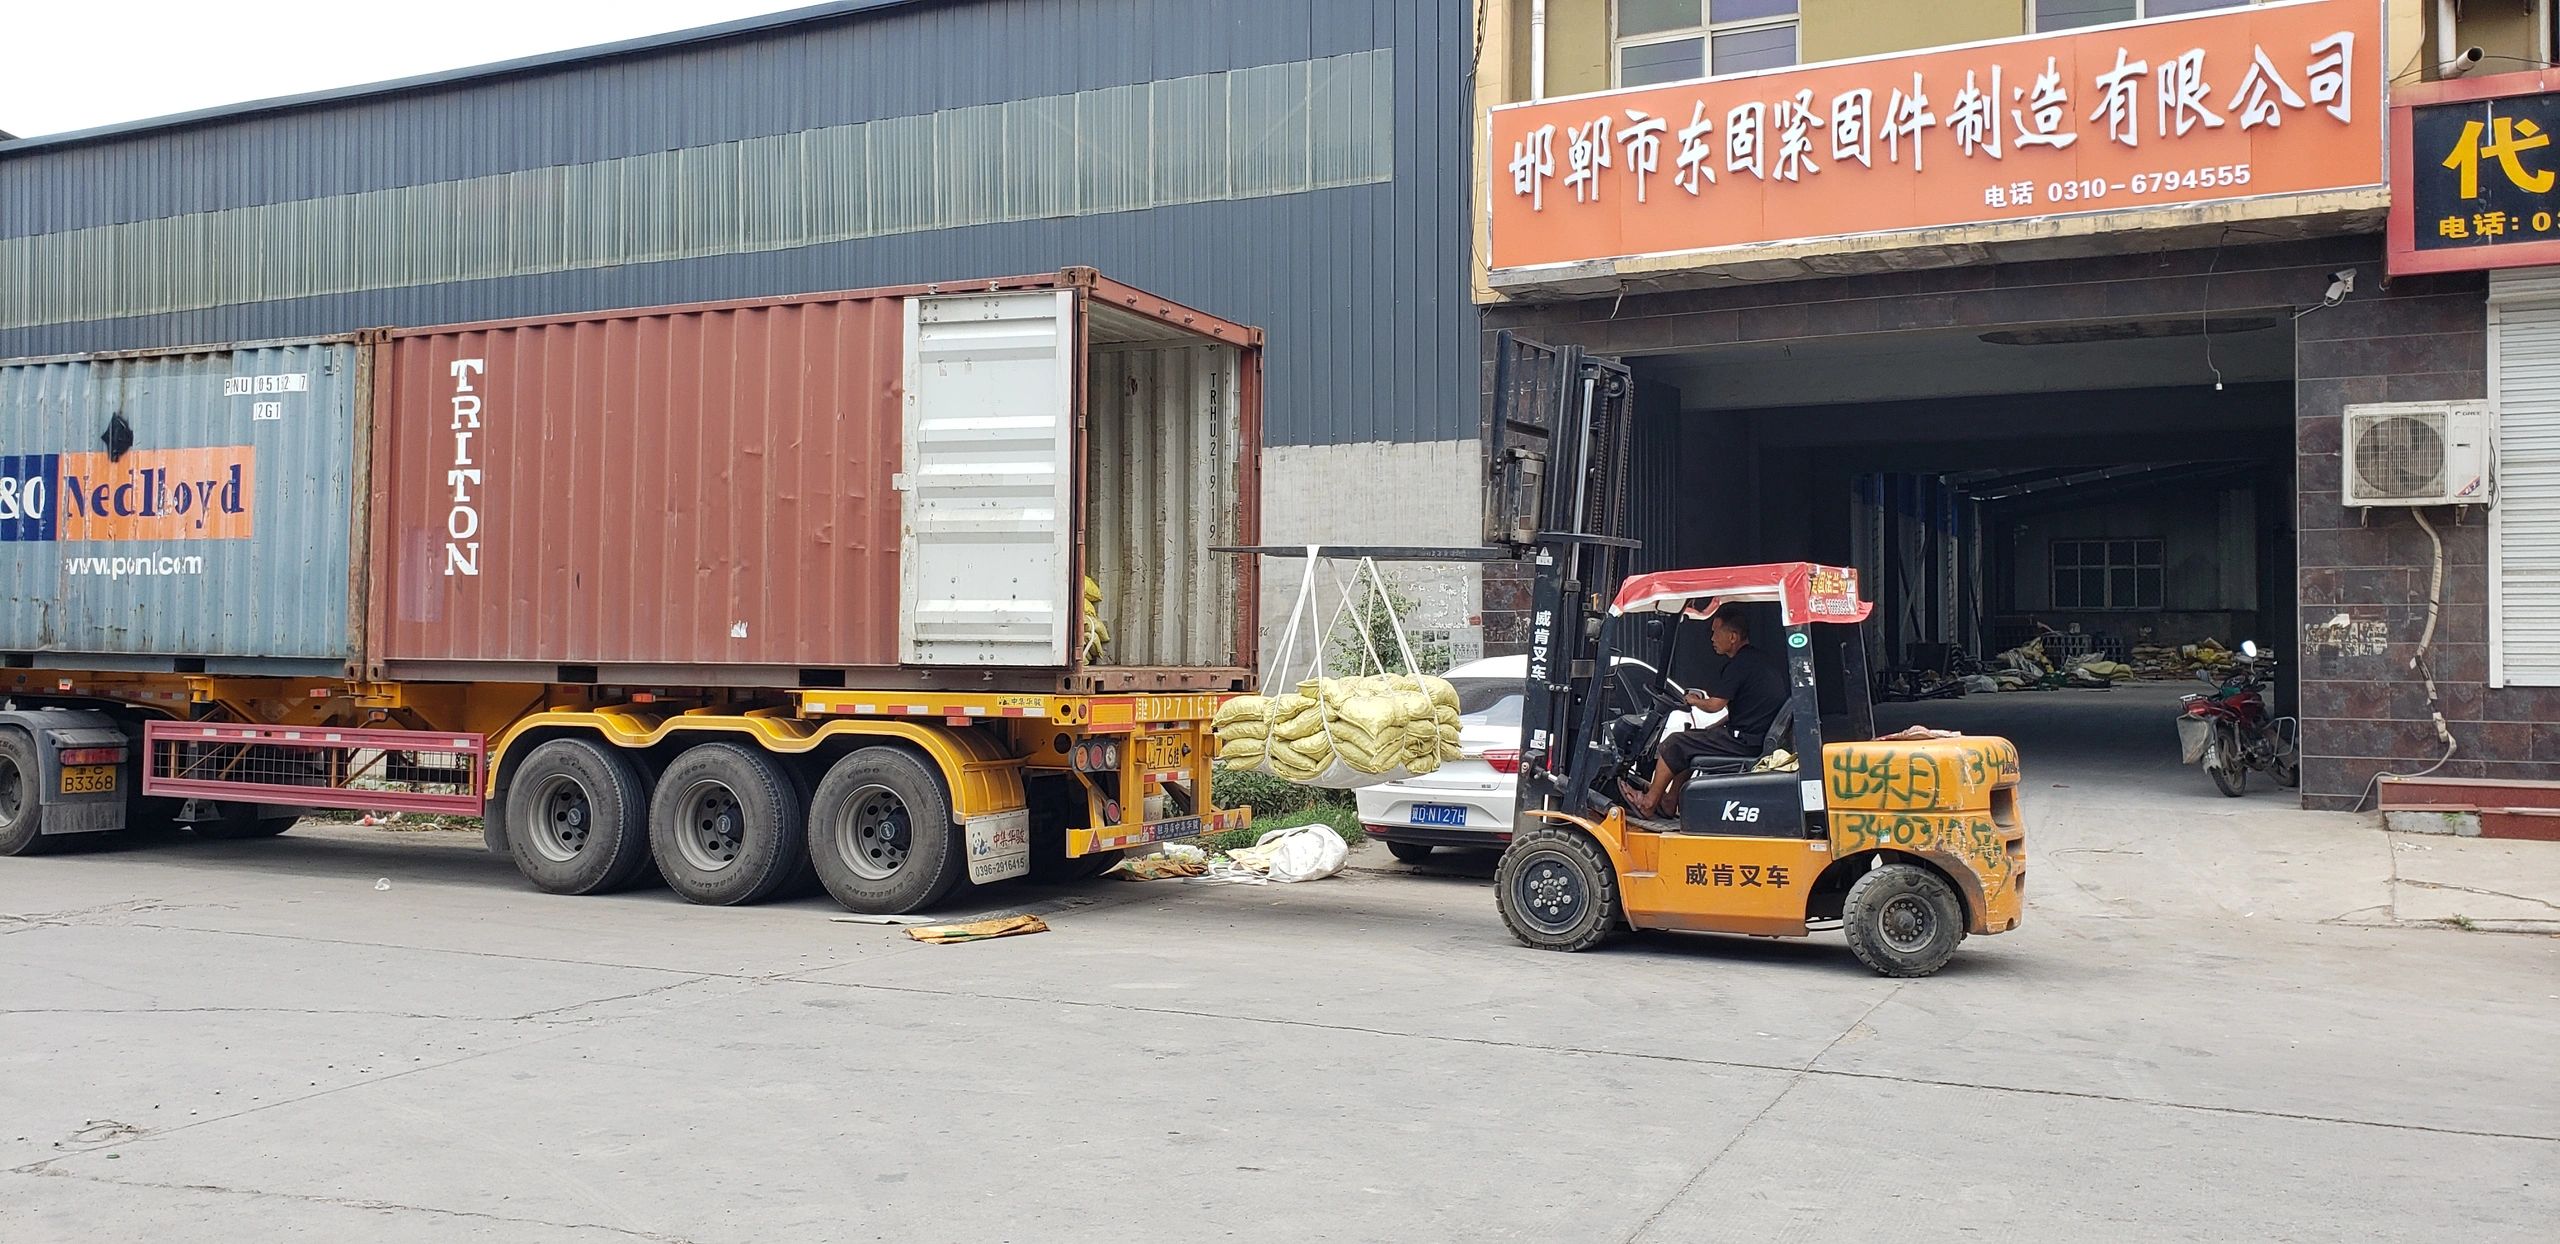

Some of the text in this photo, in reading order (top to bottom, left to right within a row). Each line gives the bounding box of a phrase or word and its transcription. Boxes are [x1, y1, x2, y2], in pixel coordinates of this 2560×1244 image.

[1508, 30, 2357, 212] 邯郸市东固紧固件制造有限公司
[2441, 116, 2556, 200] 代
[1984, 164, 2251, 208] 电话 0310-6794555
[444, 358, 484, 576] TRITON
[63, 463, 244, 529] Nedlloyd
[65, 551, 202, 581] www.ponl.com
[1530, 610, 1552, 680] 威肯叉车
[65, 776, 114, 792] B3368
[1721, 801, 1760, 823] K36
[975, 857, 1025, 878] 0396-2916415
[1685, 863, 1790, 889] 威肯叉车
